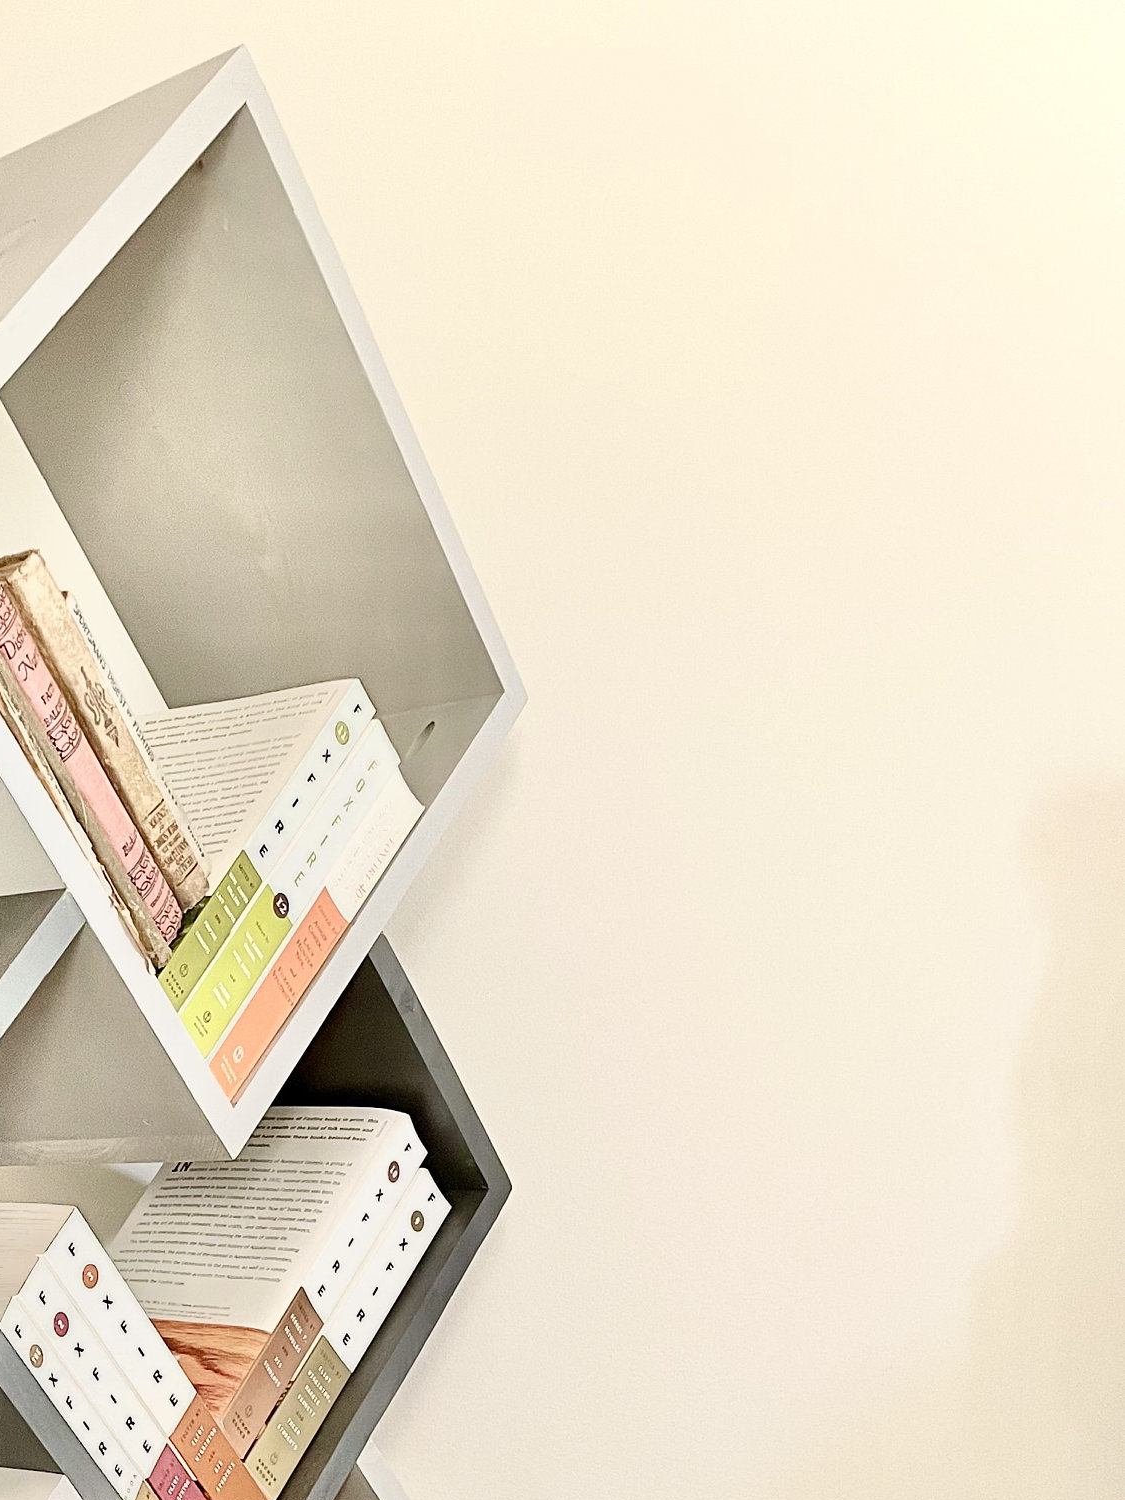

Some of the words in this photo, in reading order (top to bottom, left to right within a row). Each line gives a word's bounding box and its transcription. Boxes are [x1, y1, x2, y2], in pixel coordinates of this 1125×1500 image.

[293, 759, 377, 887] FOXFIRE
[275, 895, 287, 916] 12
[263, 1356, 280, 1391] STUDENTS
[317, 1363, 331, 1385] ELIOT
[190, 1425, 204, 1447] ELIOT
[276, 1420, 297, 1454] STUDENTS
